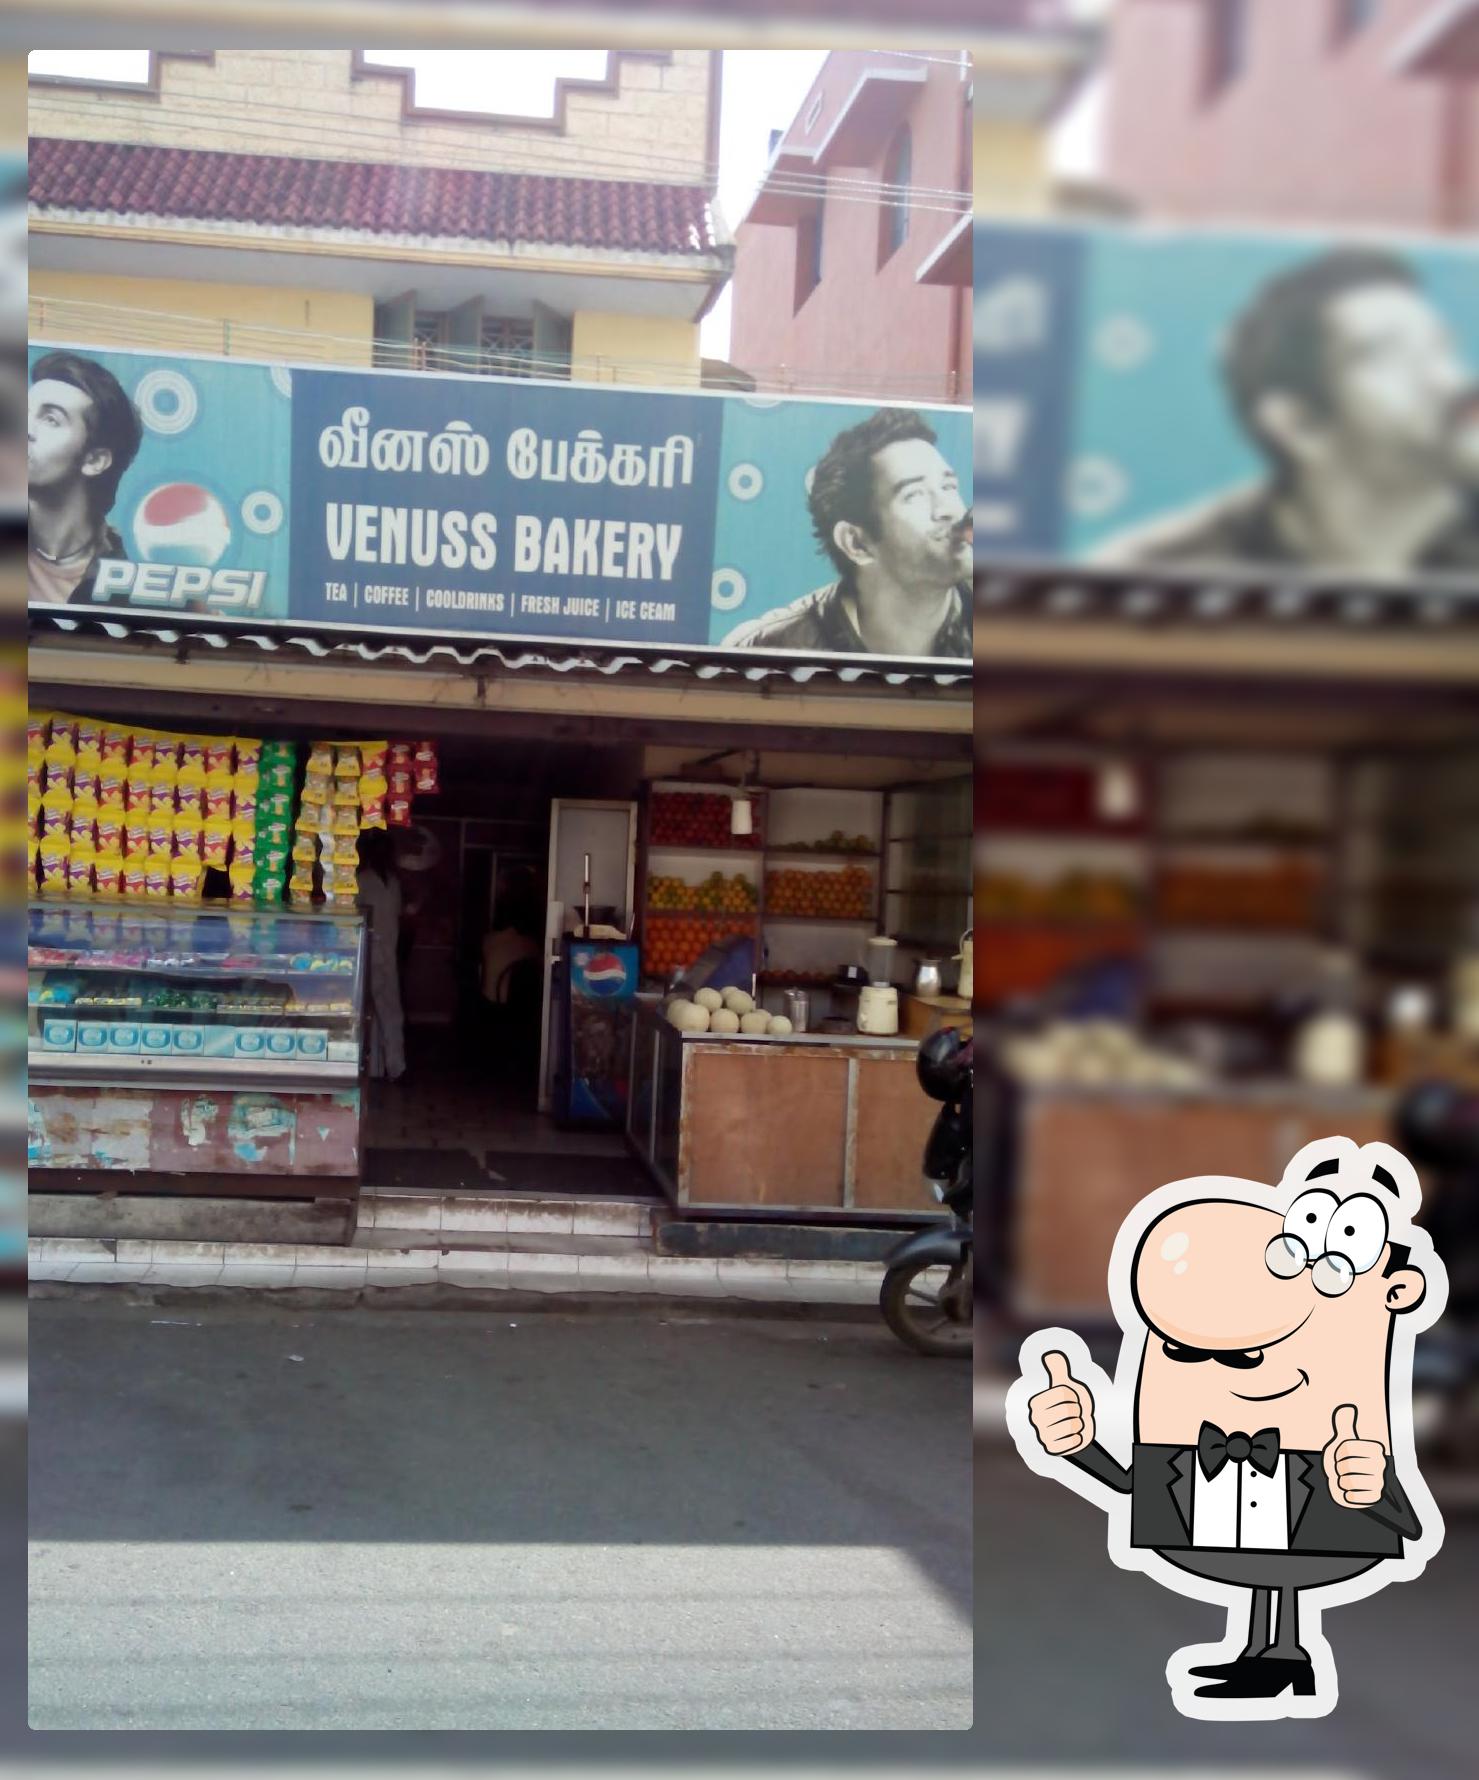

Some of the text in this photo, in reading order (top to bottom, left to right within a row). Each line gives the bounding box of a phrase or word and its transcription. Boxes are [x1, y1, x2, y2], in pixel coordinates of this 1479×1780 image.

[319, 406, 694, 488] வீனஸ் பேக்கரி
[326, 502, 683, 580] VENUSS BAKERY
[92, 559, 268, 609] PEPSI
[325, 582, 675, 622] TEA COFFEE COOLDRINKS FRESH JUICE ICE CEAM
